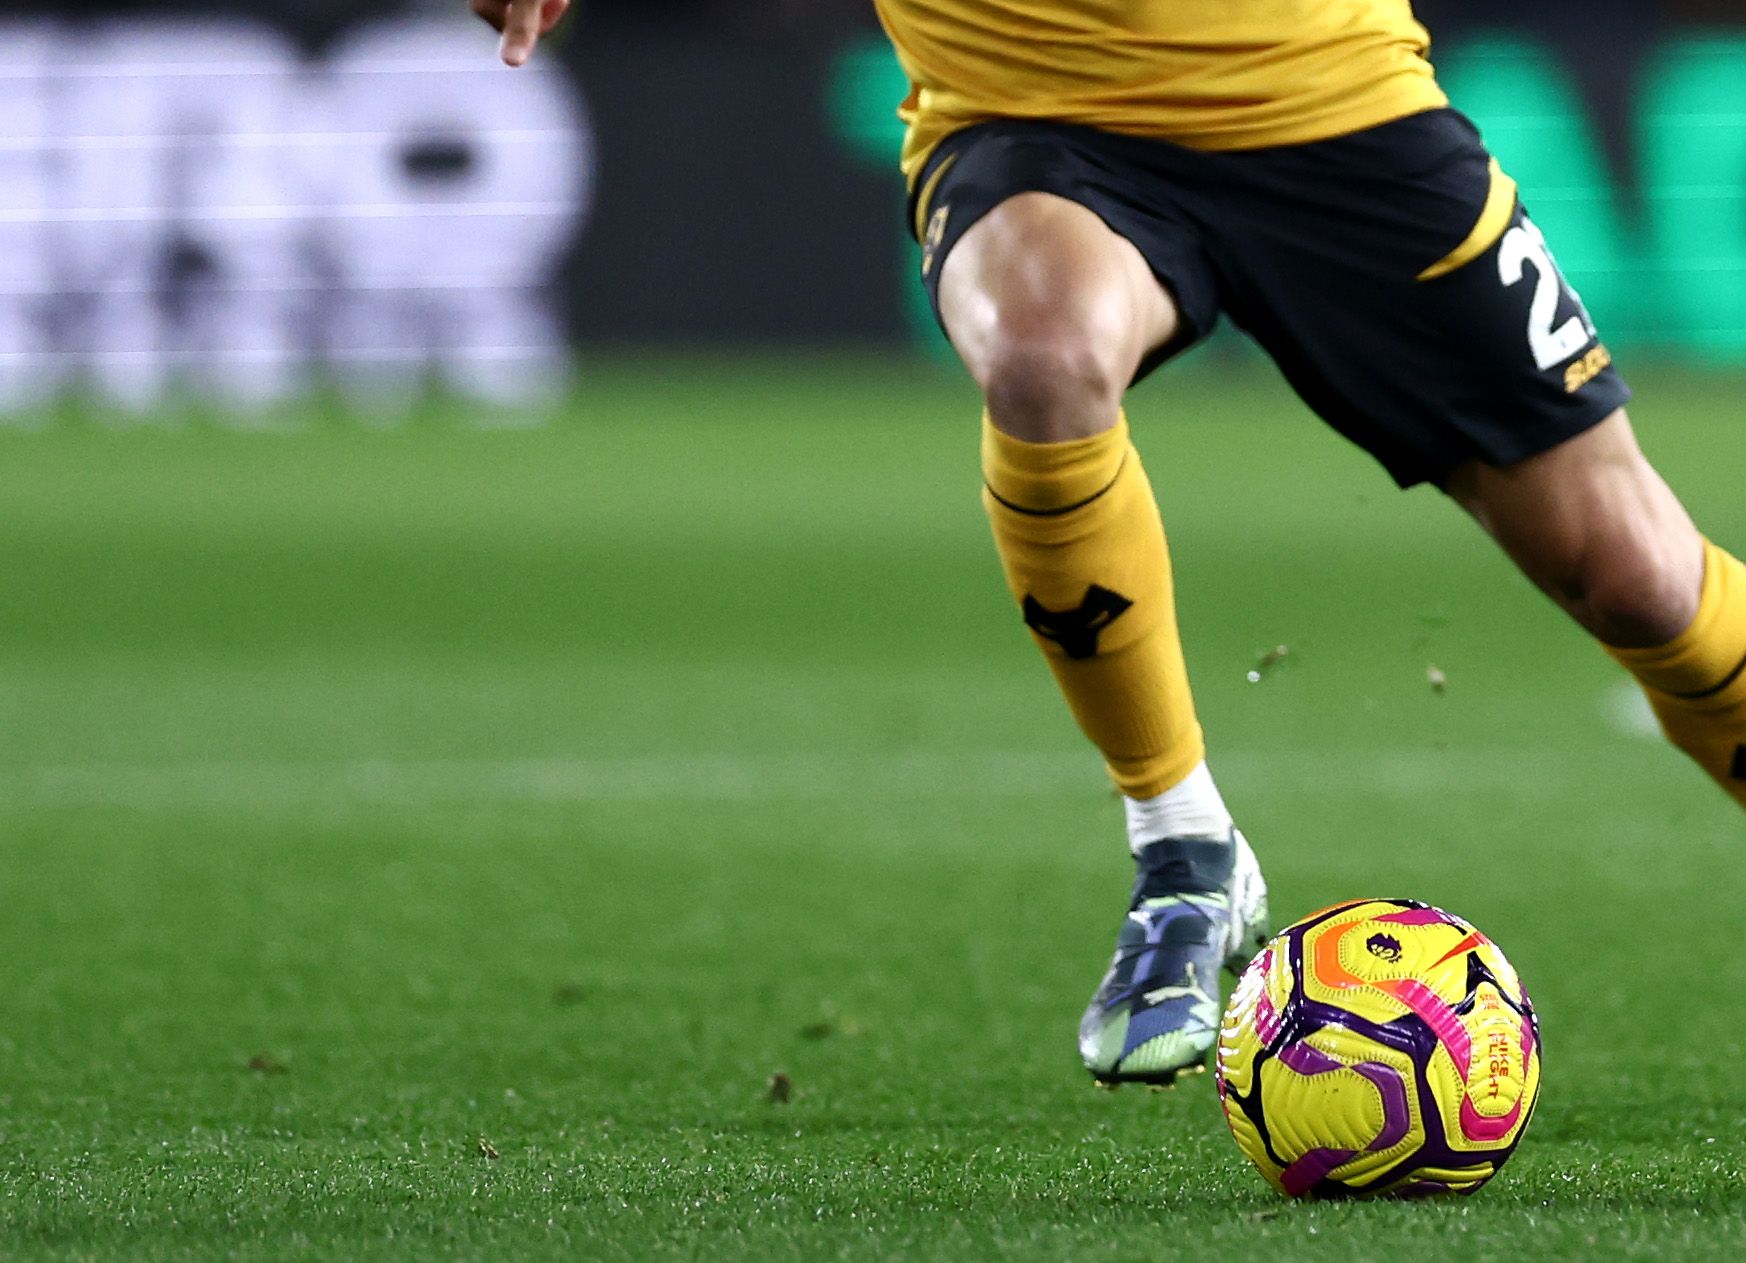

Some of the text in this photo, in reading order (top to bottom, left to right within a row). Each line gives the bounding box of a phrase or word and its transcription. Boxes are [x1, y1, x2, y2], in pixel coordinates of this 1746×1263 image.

[1497, 217, 1597, 371] 2
[1487, 1032, 1500, 1100] FLIGHT
[1499, 1032, 1509, 1077] NIKE
